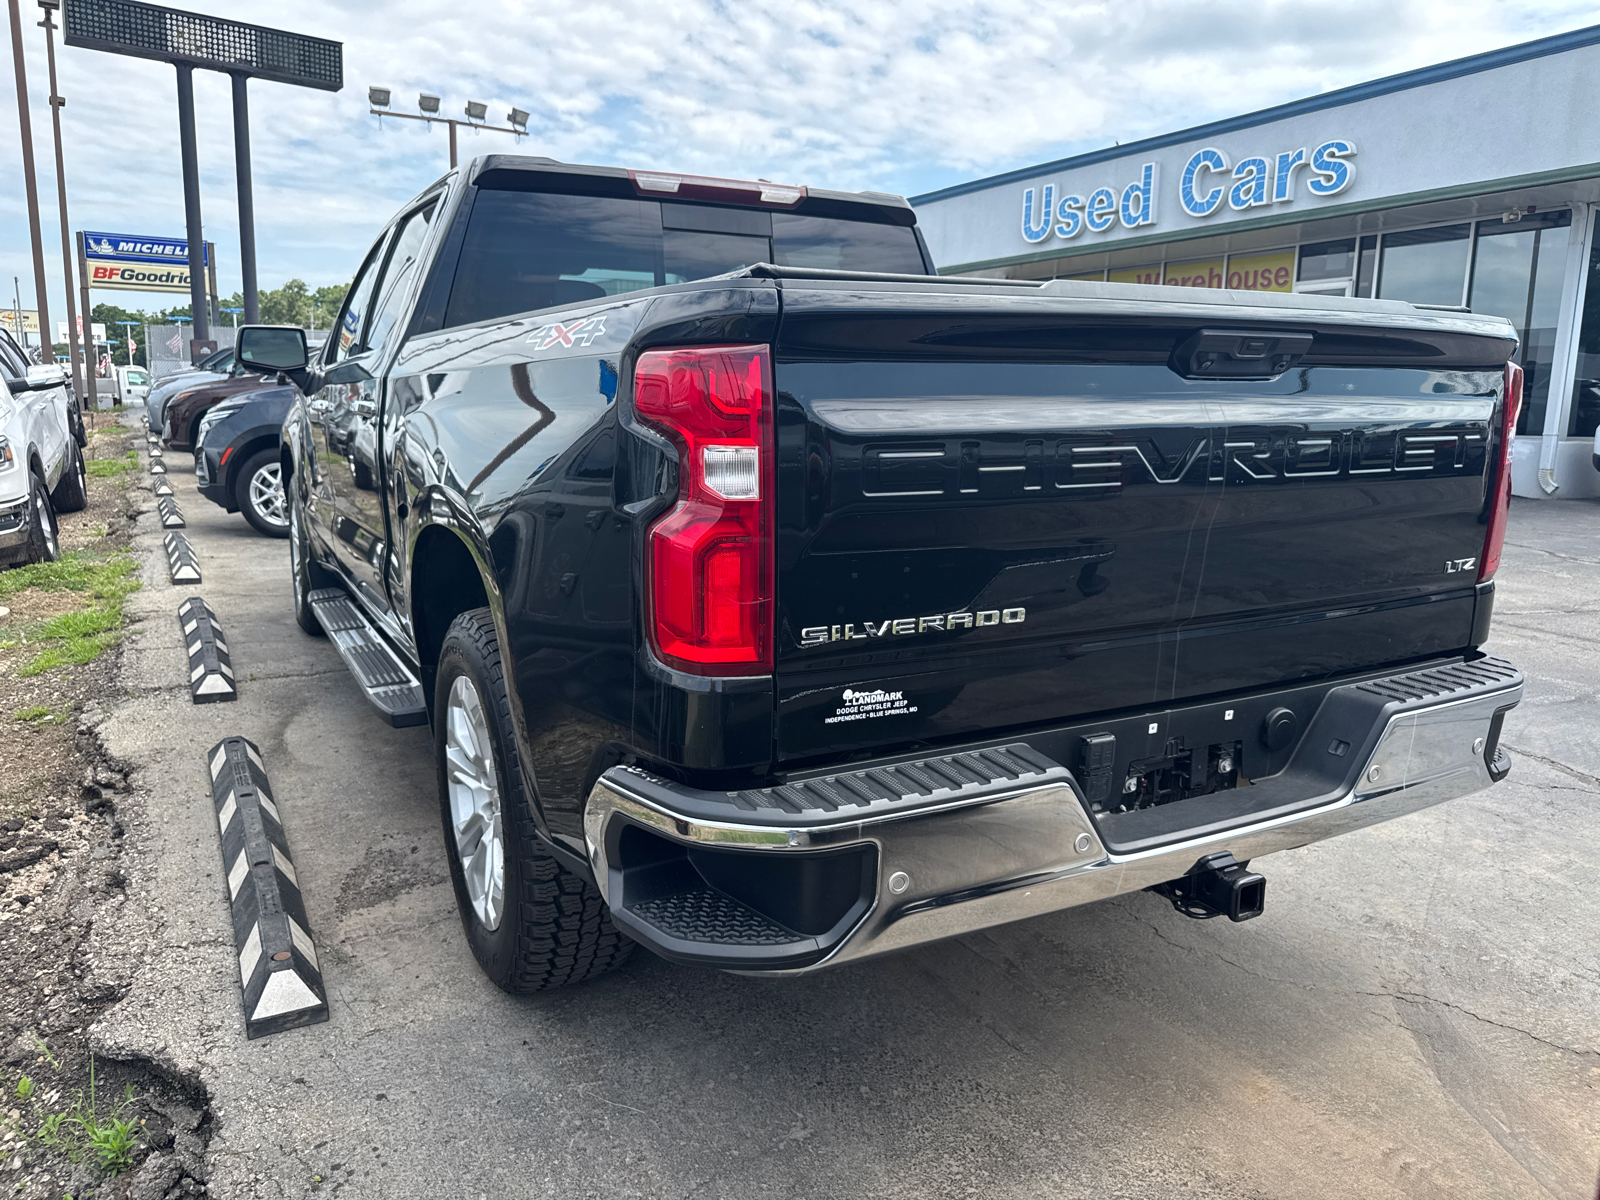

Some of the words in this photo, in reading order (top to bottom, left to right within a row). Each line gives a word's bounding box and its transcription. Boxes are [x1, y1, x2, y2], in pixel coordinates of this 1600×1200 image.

[1020, 161, 1160, 244] Used
[1178, 139, 1357, 218] Cars
[118, 242, 189, 256] MICHELI
[93, 266, 191, 284] BFGoodric
[861, 433, 1482, 497] CHEVROLET
[1443, 557, 1476, 573] LTZ
[801, 607, 1026, 645] SILVERADO
[852, 691, 903, 705] LANDMARK
[825, 713, 867, 723] INDEPENDENCE
[884, 708, 909, 716] SPRINGS,
[836, 706, 858, 714] DODGE
[860, 702, 891, 711] CHRYSLER
